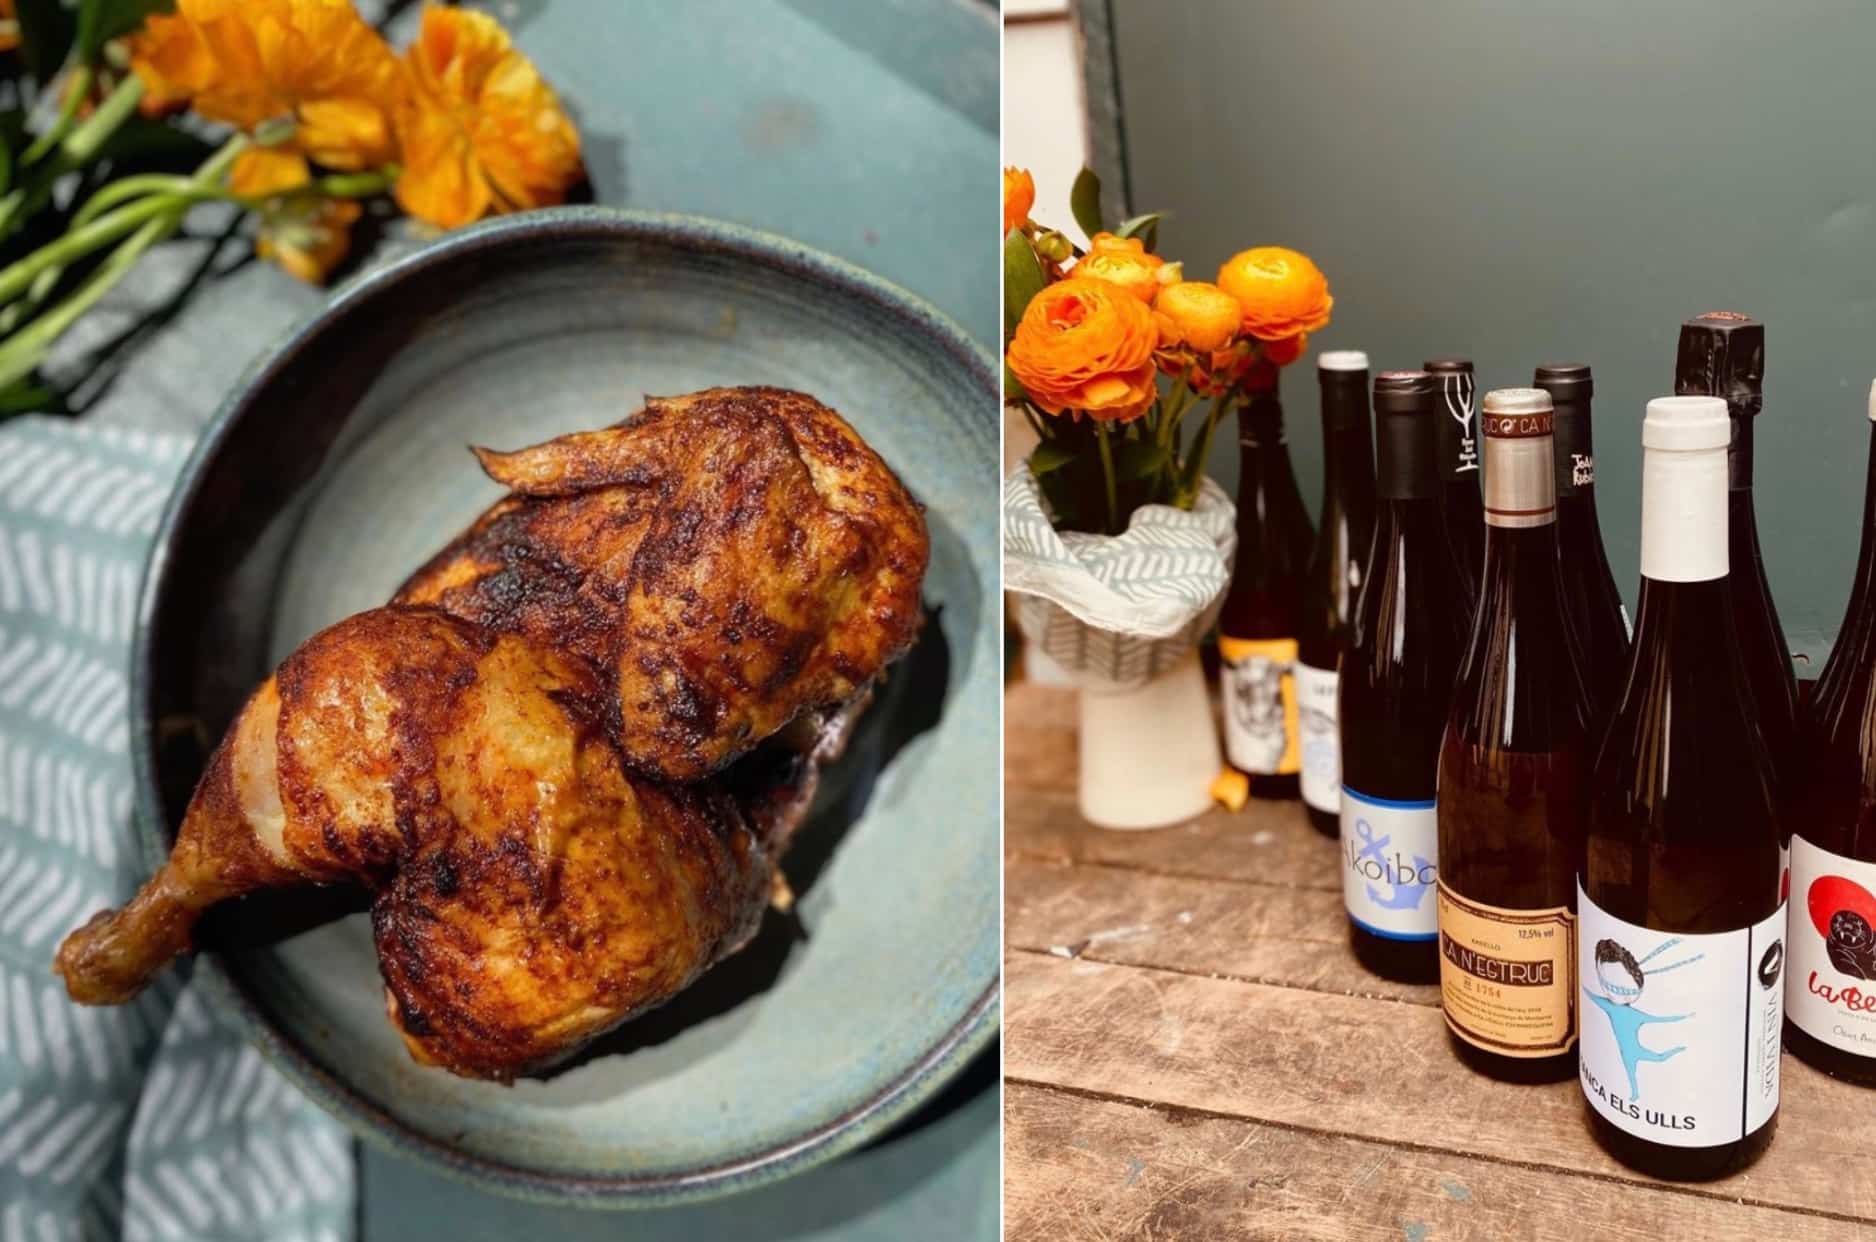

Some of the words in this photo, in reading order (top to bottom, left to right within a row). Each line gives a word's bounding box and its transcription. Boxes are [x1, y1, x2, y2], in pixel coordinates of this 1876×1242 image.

[1520, 417, 1539, 433] CA
[1609, 1093, 1640, 1120] ELS
[1645, 1108, 1697, 1130] ULLS
